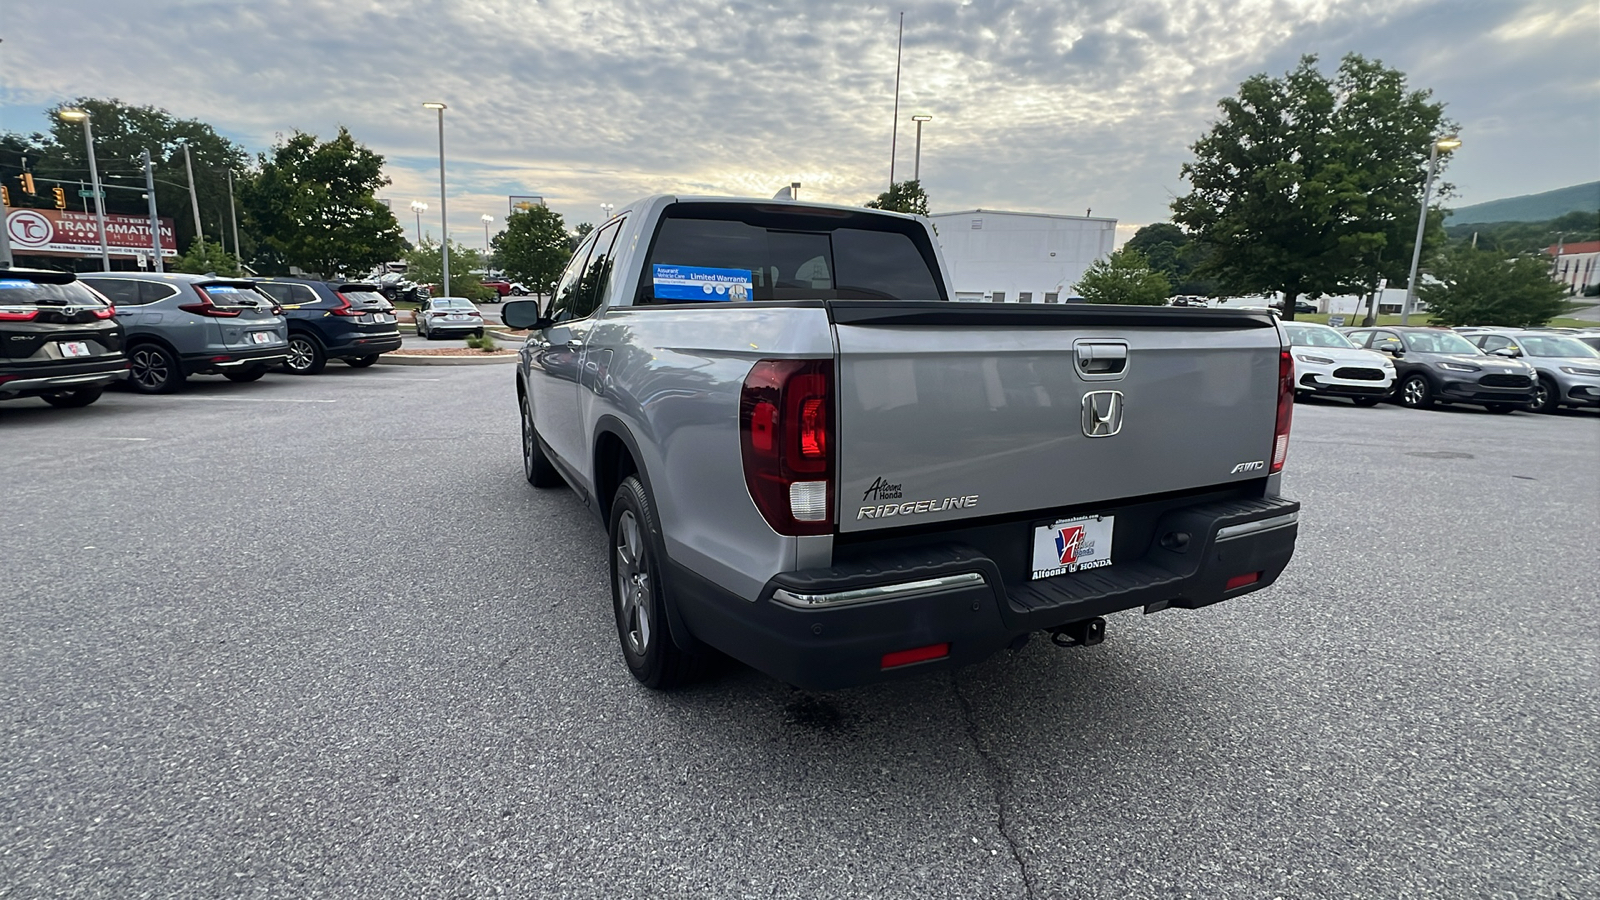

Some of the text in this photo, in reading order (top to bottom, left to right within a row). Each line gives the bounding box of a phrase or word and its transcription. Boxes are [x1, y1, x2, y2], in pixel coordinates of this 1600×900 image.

[55, 220, 172, 236] TRAN4MATION
[690, 273, 748, 283] Limited Warranty
[1230, 461, 1264, 474] AWD
[880, 491, 902, 500] Honda
[857, 495, 979, 520] RIDGELINE
[1032, 559, 1112, 580] Altoona HONDA
